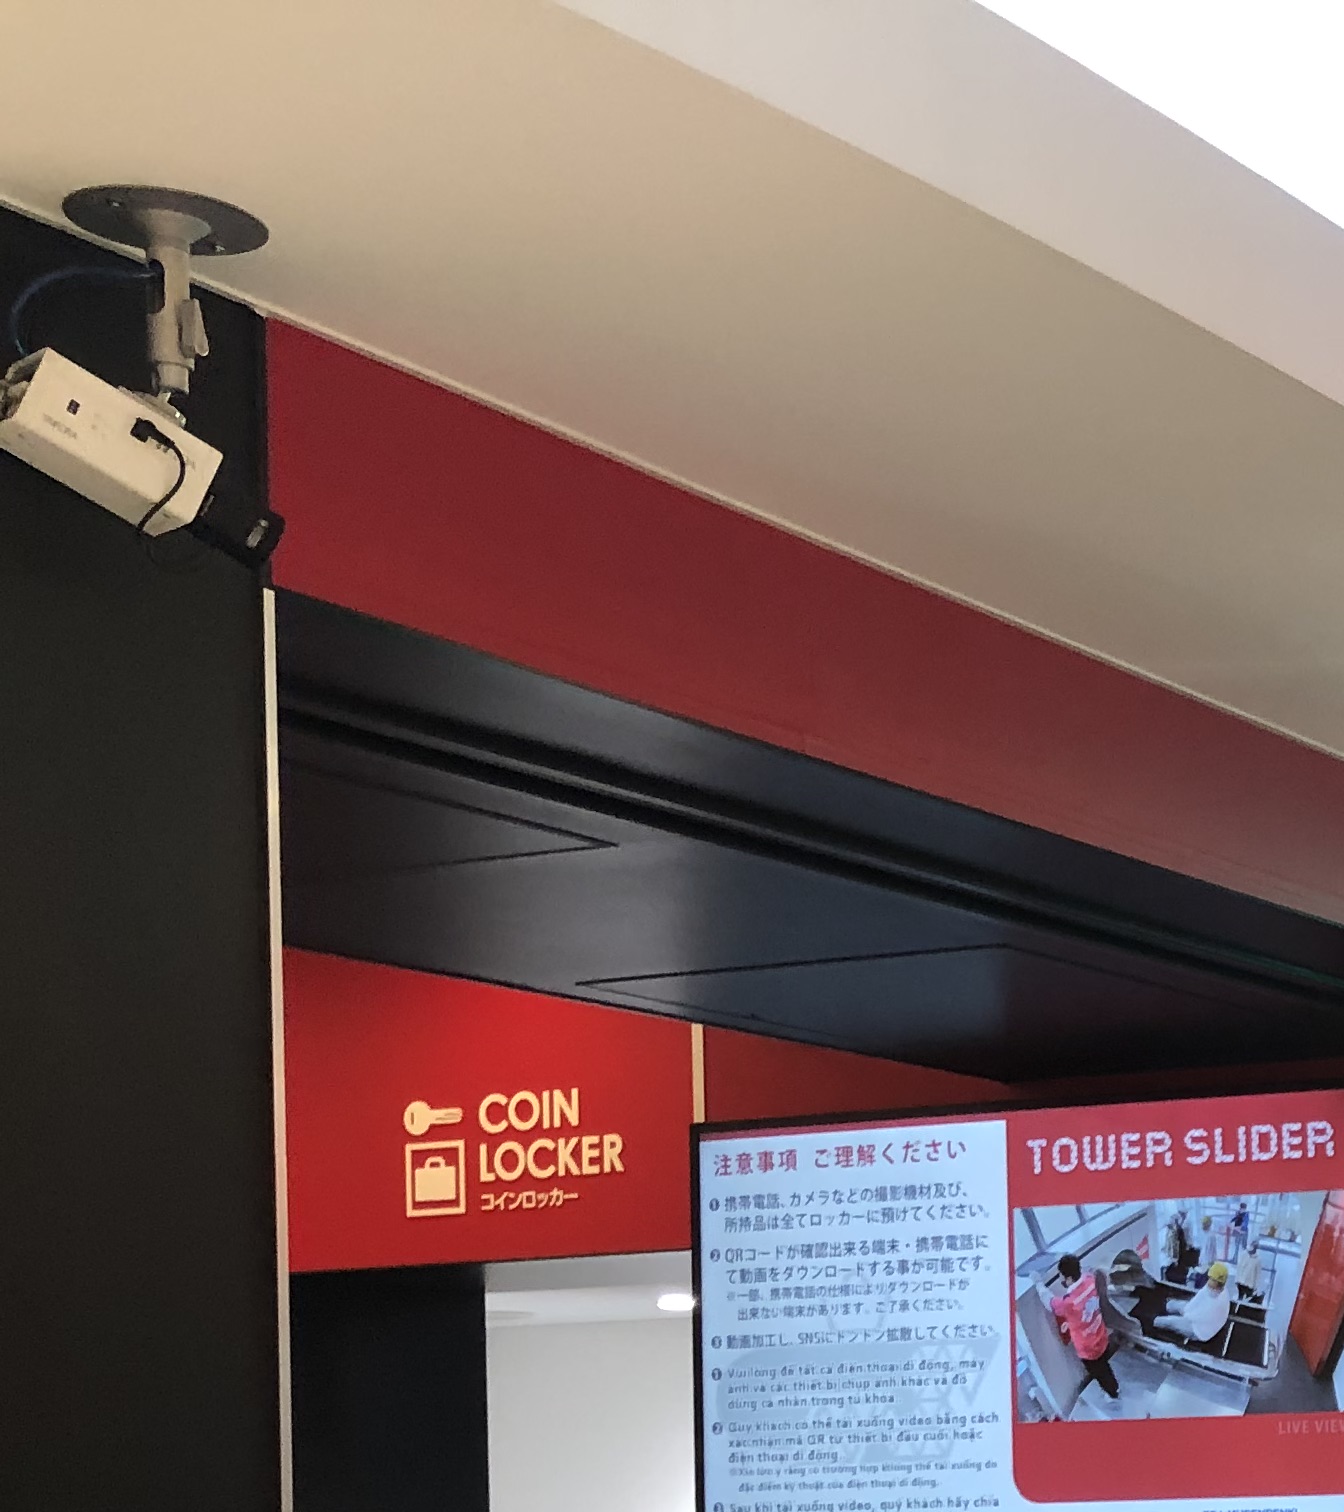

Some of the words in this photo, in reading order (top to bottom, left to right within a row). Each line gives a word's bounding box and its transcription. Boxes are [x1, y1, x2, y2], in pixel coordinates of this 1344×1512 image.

[478, 1087, 579, 1134] COIN
[479, 1133, 625, 1182] LOCKER
[714, 1149, 798, 1177] 注意事項
[814, 1139, 967, 1169] ご理解ください
[1026, 1129, 1174, 1175] TOWER
[1183, 1119, 1335, 1166] SLIDER
[480, 1187, 579, 1211] コインロッカー
[900, 1415, 932, 1426] video
[1278, 1420, 1310, 1435] LIVE
[807, 1434, 825, 1446] QR
[755, 1502, 773, 1512] khi
